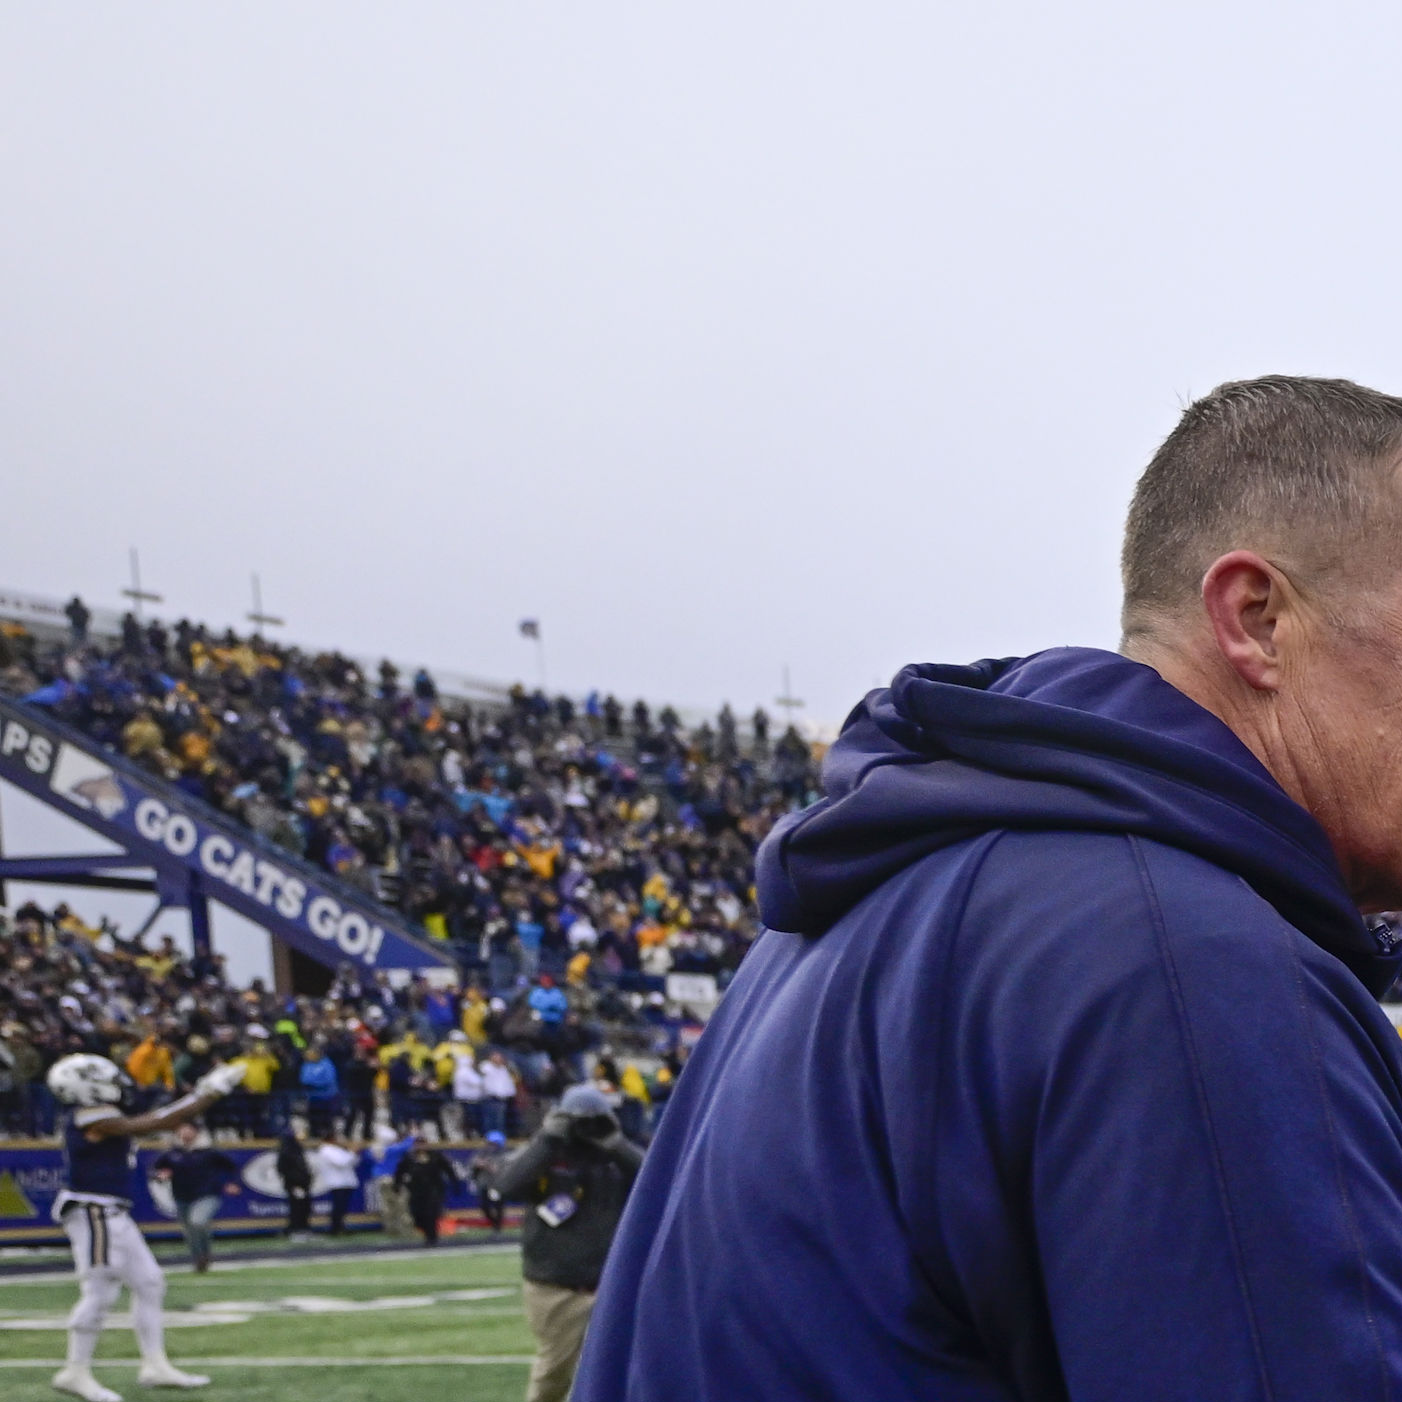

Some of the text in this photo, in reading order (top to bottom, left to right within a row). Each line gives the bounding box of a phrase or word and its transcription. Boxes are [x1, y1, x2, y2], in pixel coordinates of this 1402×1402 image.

[134, 798, 385, 964] GO CATS GO!
